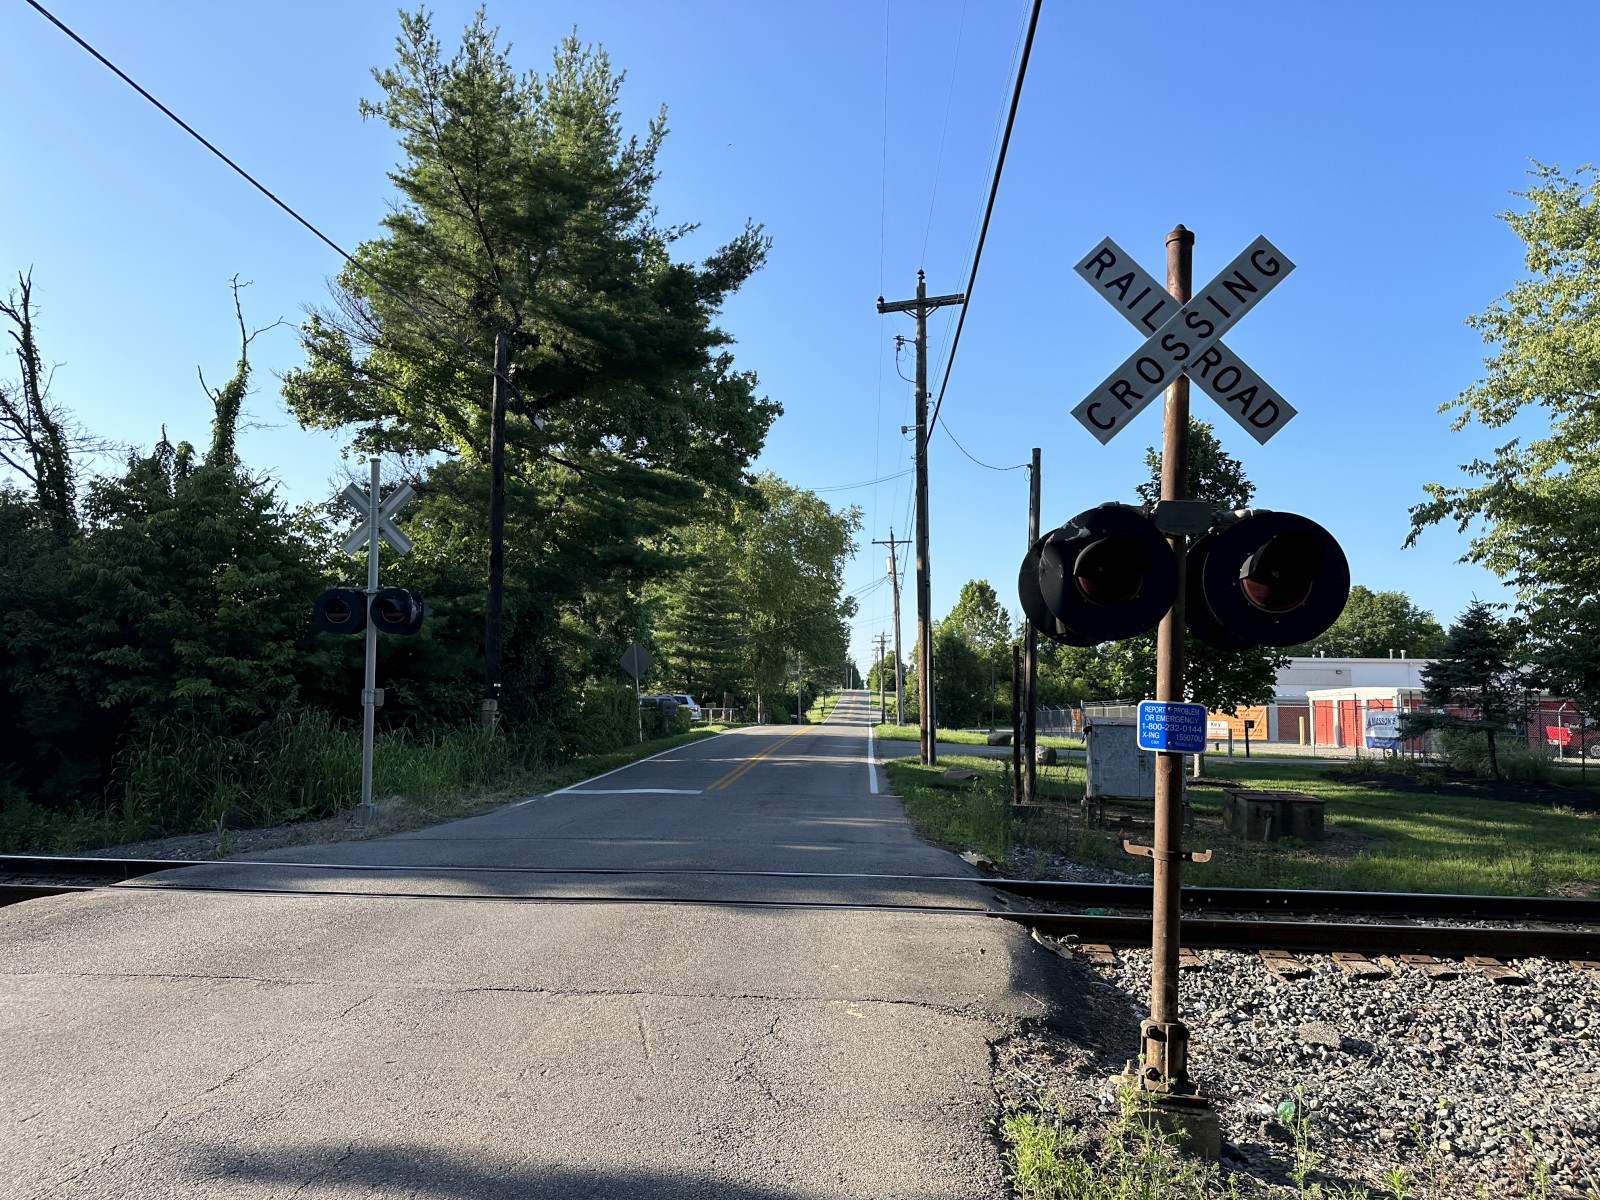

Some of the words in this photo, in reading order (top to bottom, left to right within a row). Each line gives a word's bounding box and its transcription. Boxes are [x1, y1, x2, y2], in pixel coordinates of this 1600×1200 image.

[1084, 247, 1166, 333] RAIL
[1190, 346, 1280, 428] ROAD
[1086, 249, 1281, 431] CROSSING
[1144, 705, 1166, 714] REPORT
[1173, 707, 1200, 716] PROBLEM
[1144, 714, 1155, 722] OR
[1155, 714, 1200, 724] EMERGENCY
[1141, 722, 1202, 733] 1-800-232-0144
[1142, 731, 1160, 739] X-ING
